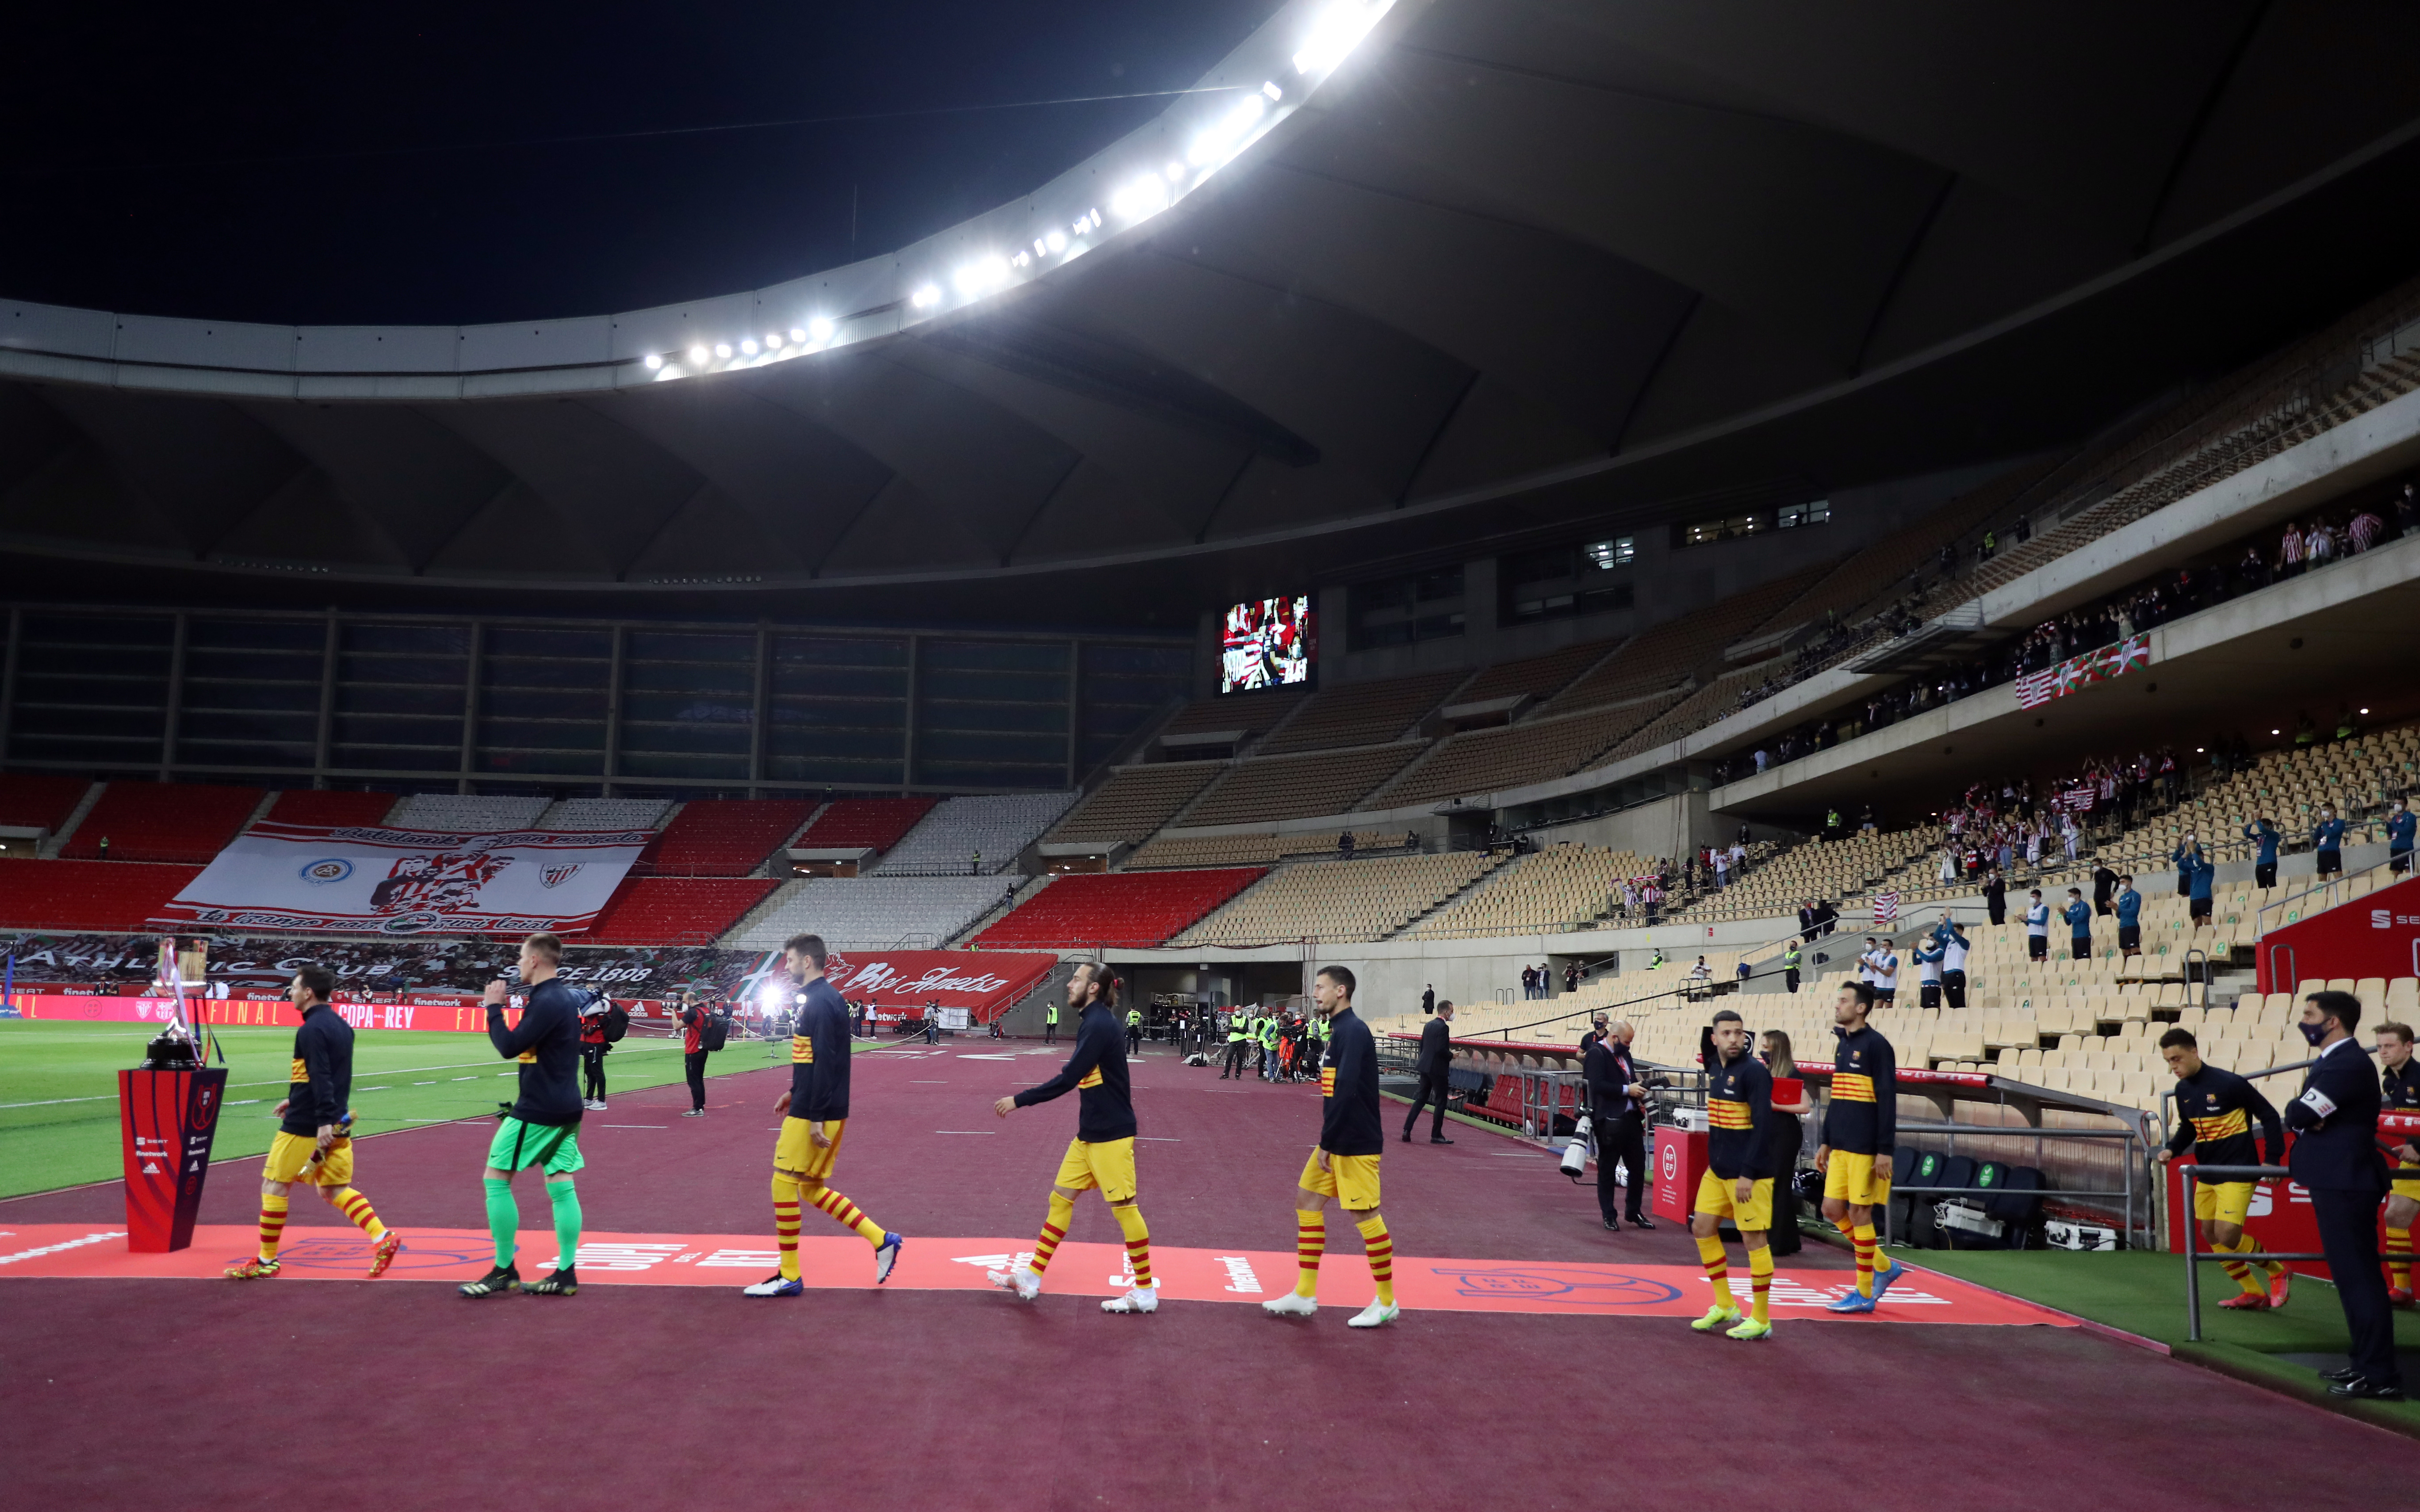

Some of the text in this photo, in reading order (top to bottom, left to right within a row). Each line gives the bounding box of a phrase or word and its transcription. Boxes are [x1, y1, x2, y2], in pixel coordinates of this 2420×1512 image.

[234, 912, 322, 927] izango
[494, 917, 555, 930] leial
[16, 950, 653, 981] ATHLIC CUB SCE 1898
[414, 997, 461, 1006] finetwork
[210, 1001, 278, 1024] FINAL
[385, 1007, 414, 1028] REY
[1666, 1153, 1673, 1161] RF
[1666, 1162, 1673, 1171] EF
[673, 1252, 703, 1262] DEL
[1214, 1256, 1263, 1293] finetwork
